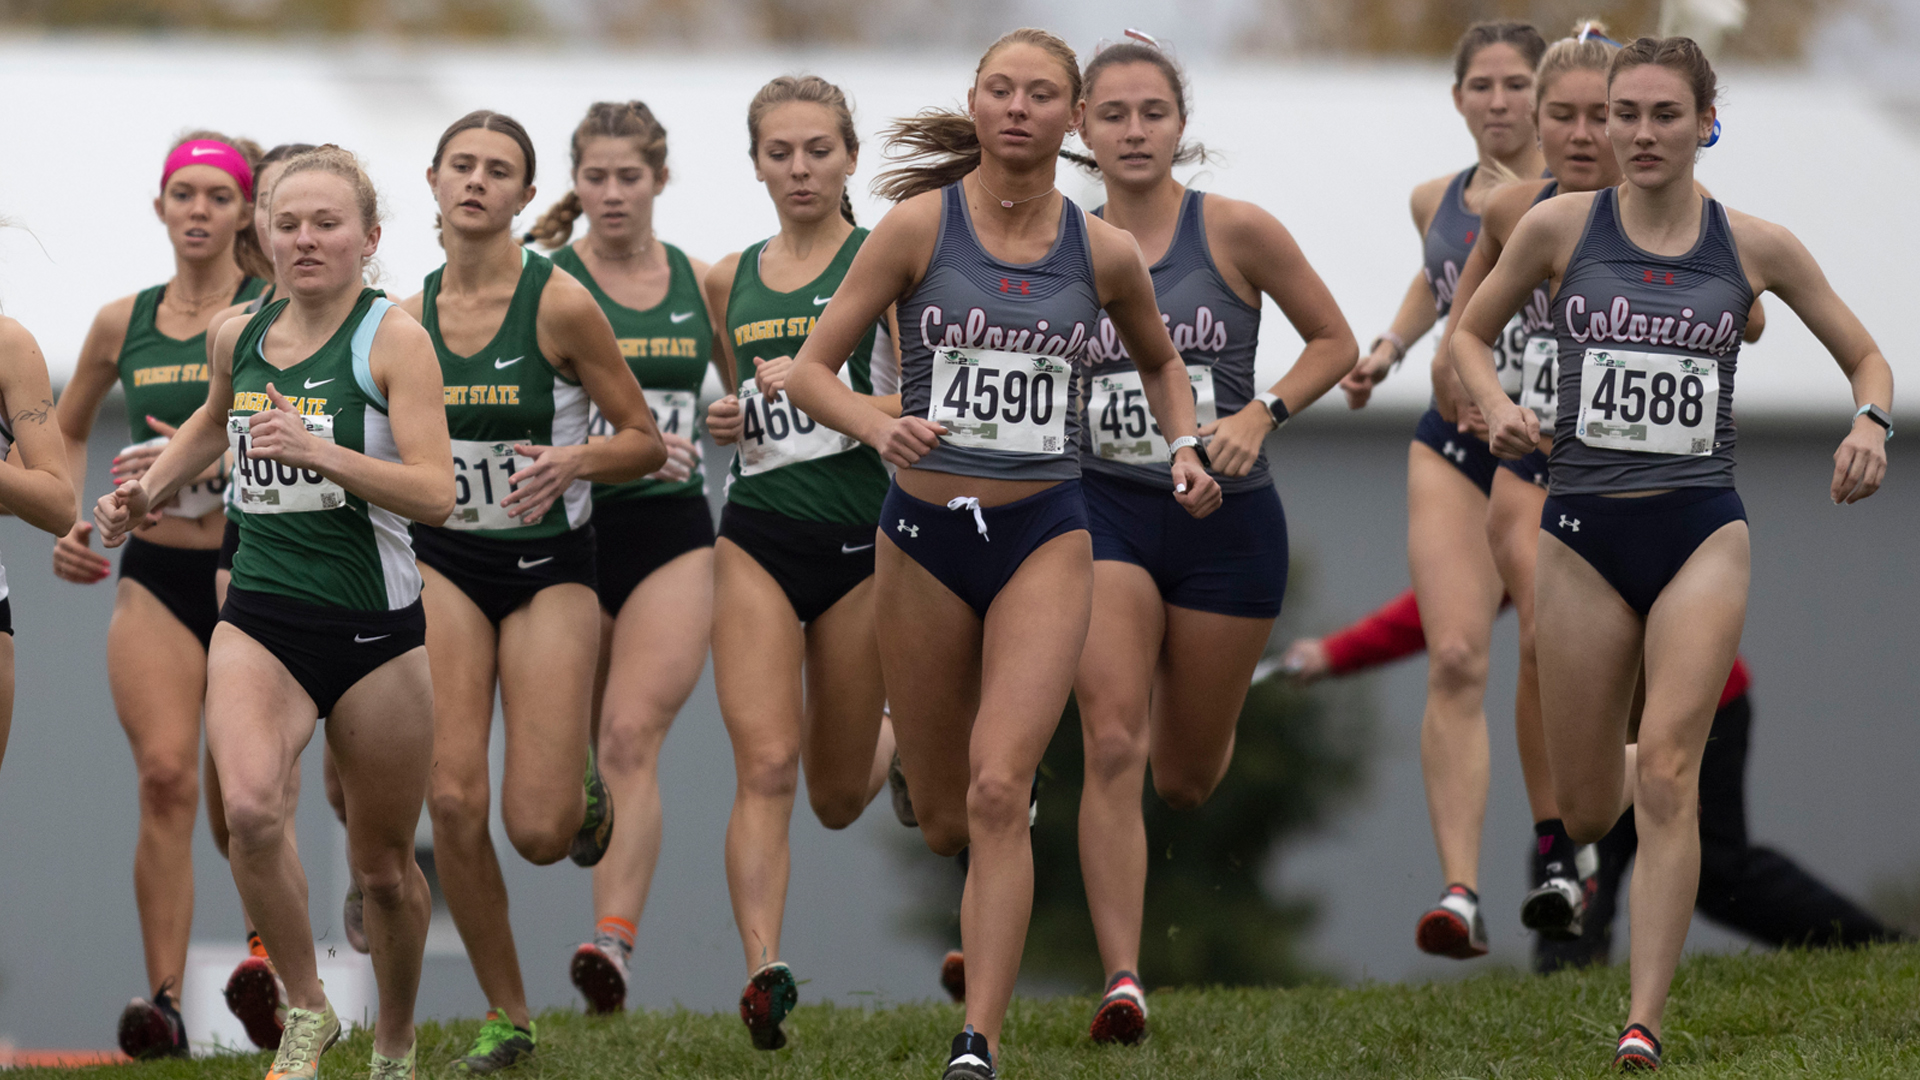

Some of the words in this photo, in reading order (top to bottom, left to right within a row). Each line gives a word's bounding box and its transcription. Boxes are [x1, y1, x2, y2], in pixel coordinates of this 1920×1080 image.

[735, 319, 785, 346] WRIGHT
[787, 316, 818, 337] STA
[1566, 295, 1738, 357] Colonials
[649, 337, 697, 358] STATE
[181, 363, 209, 382] STA
[283, 396, 328, 415] TATE
[443, 385, 469, 405] GHT
[469, 385, 520, 405] STATE
[943, 366, 1054, 426] 4590
[1591, 368, 1704, 428] 4588
[453, 457, 521, 505] 611
